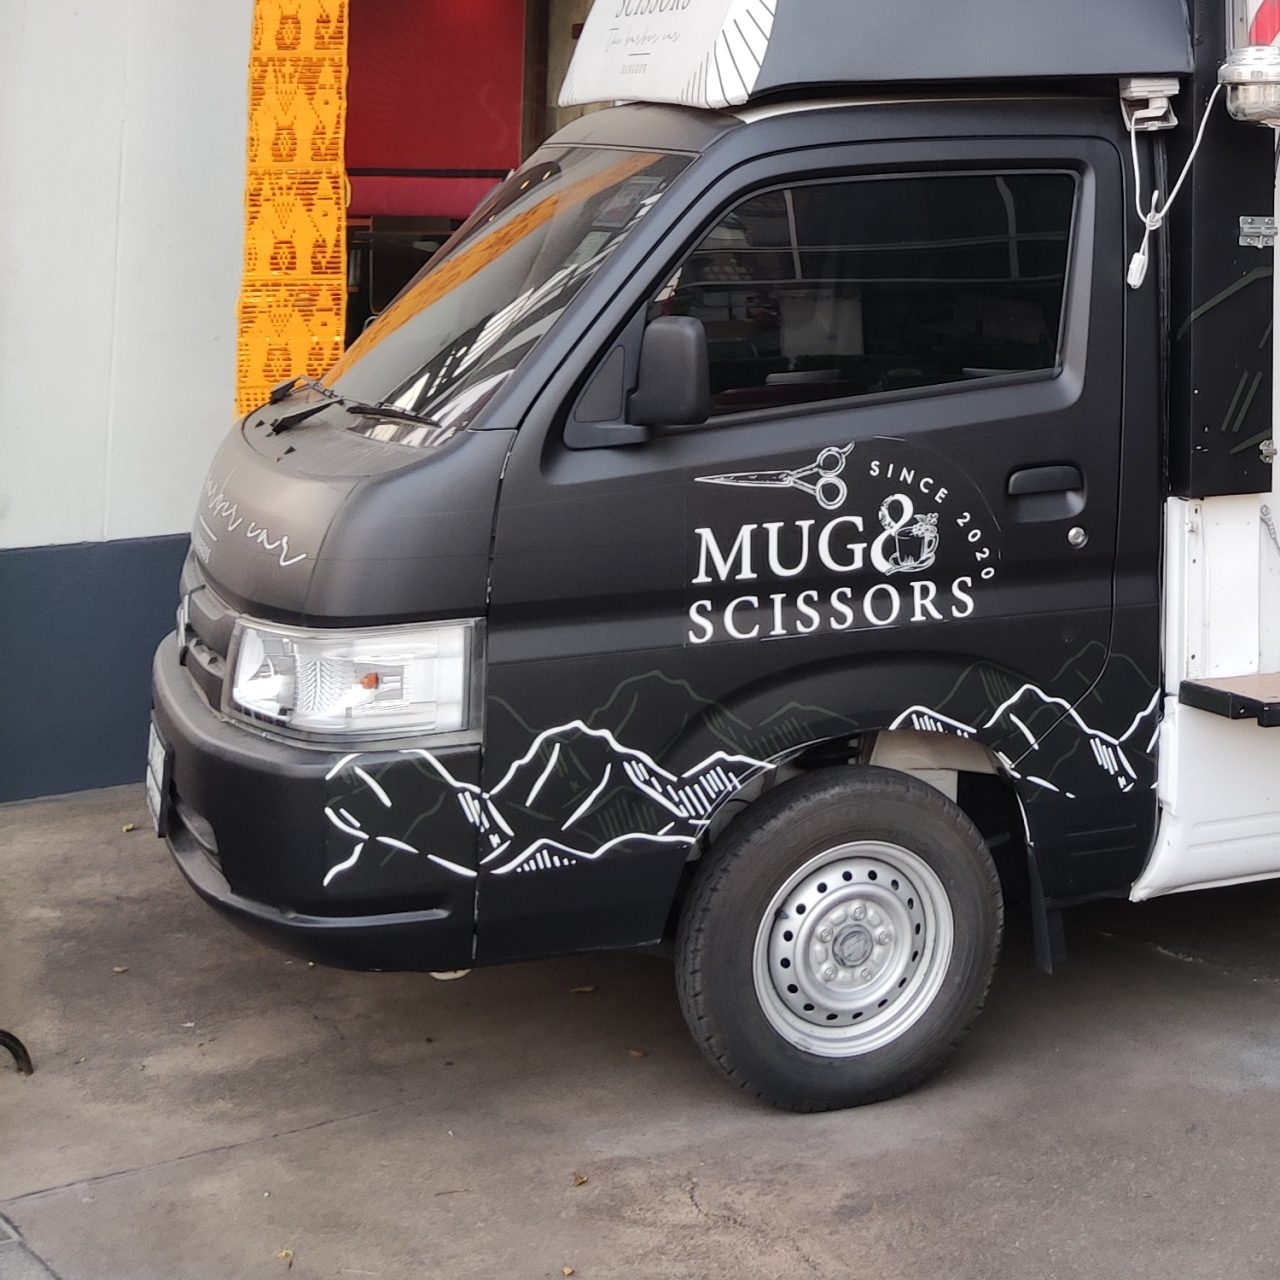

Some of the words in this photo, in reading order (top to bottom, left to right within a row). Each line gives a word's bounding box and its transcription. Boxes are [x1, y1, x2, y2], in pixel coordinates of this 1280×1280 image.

[869, 460, 948, 504] SINCE
[956, 512, 995, 580] 2020
[688, 576, 974, 644] SCISSORS
